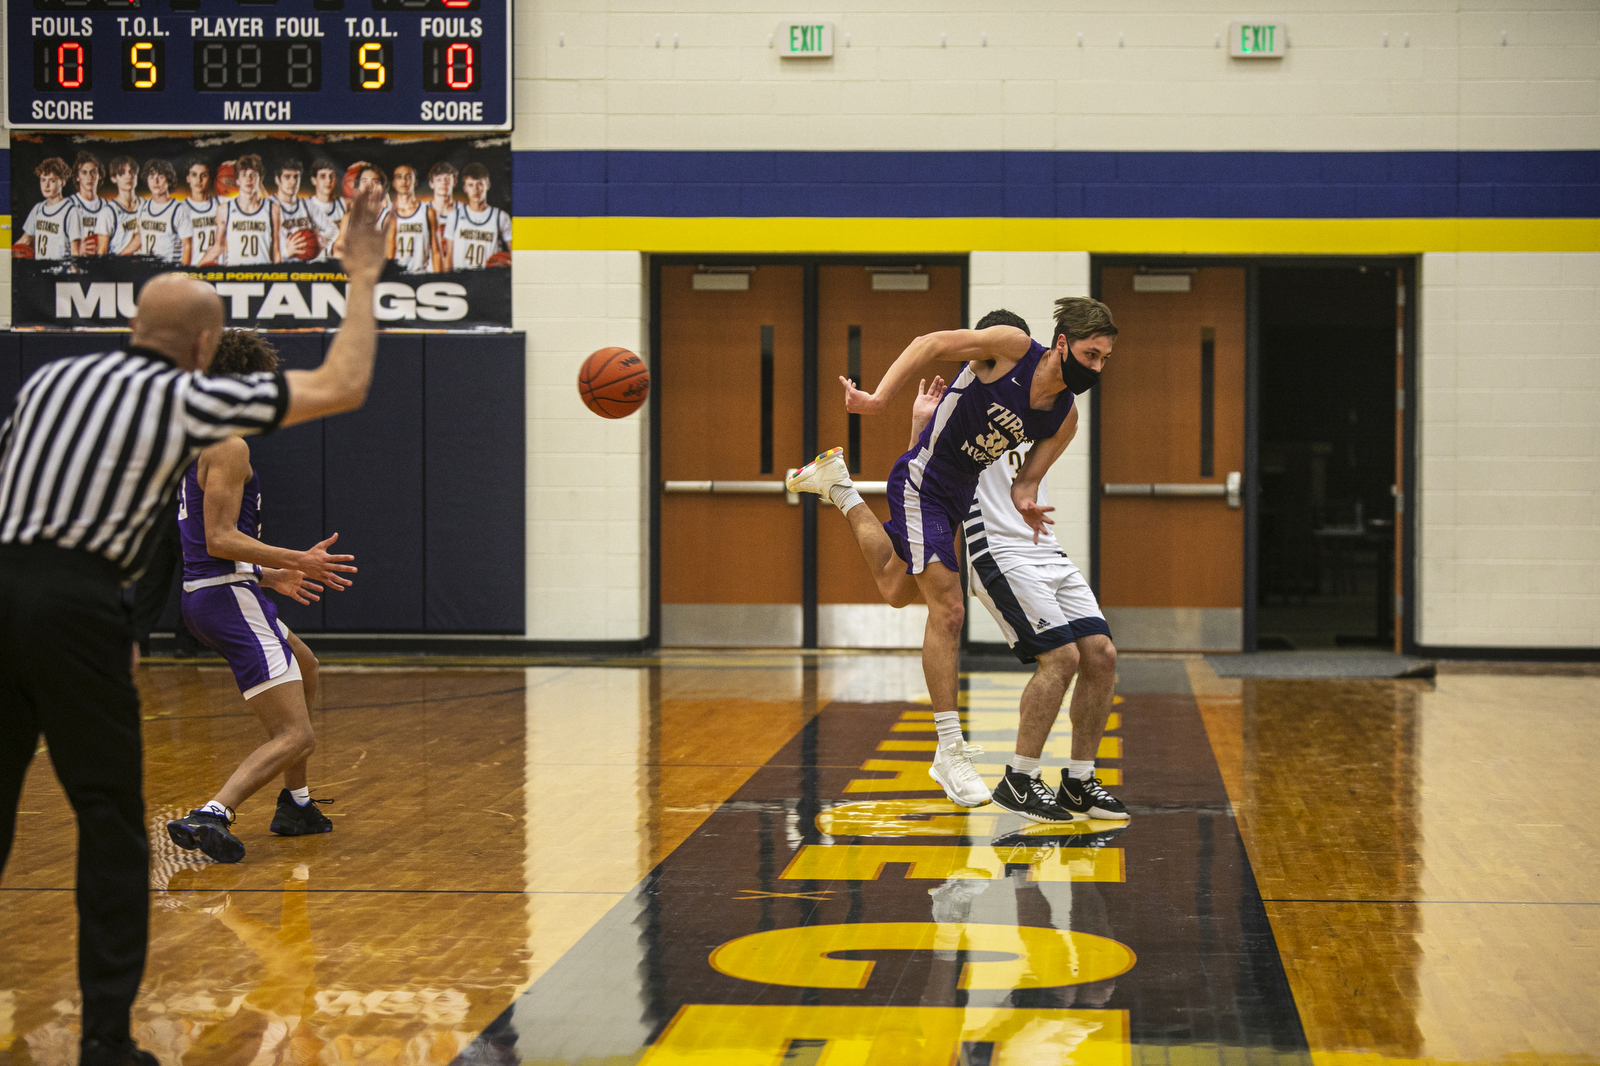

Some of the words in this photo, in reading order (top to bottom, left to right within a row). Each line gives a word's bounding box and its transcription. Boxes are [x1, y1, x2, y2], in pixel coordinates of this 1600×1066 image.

[31, 17, 93, 37] FOULS
[117, 17, 170, 37] T.O.L.
[191, 17, 263, 37] PLAYER
[276, 17, 325, 37] FOUL
[345, 17, 398, 37] T.O.L.
[420, 17, 483, 37] FOULS
[790, 25, 825, 52] EXIT
[1241, 25, 1276, 53] EXIT
[57, 42, 84, 88] 0
[131, 42, 157, 89] 5
[358, 42, 386, 89] 5
[446, 42, 473, 90] 0
[31, 100, 94, 120] SCORE
[223, 101, 291, 121] MATCH
[420, 101, 483, 121] SCORE
[240, 234, 259, 257] 20
[464, 242, 485, 268] 40
[226, 272, 288, 281] PORTAGE
[55, 281, 469, 321] MUTANGS
